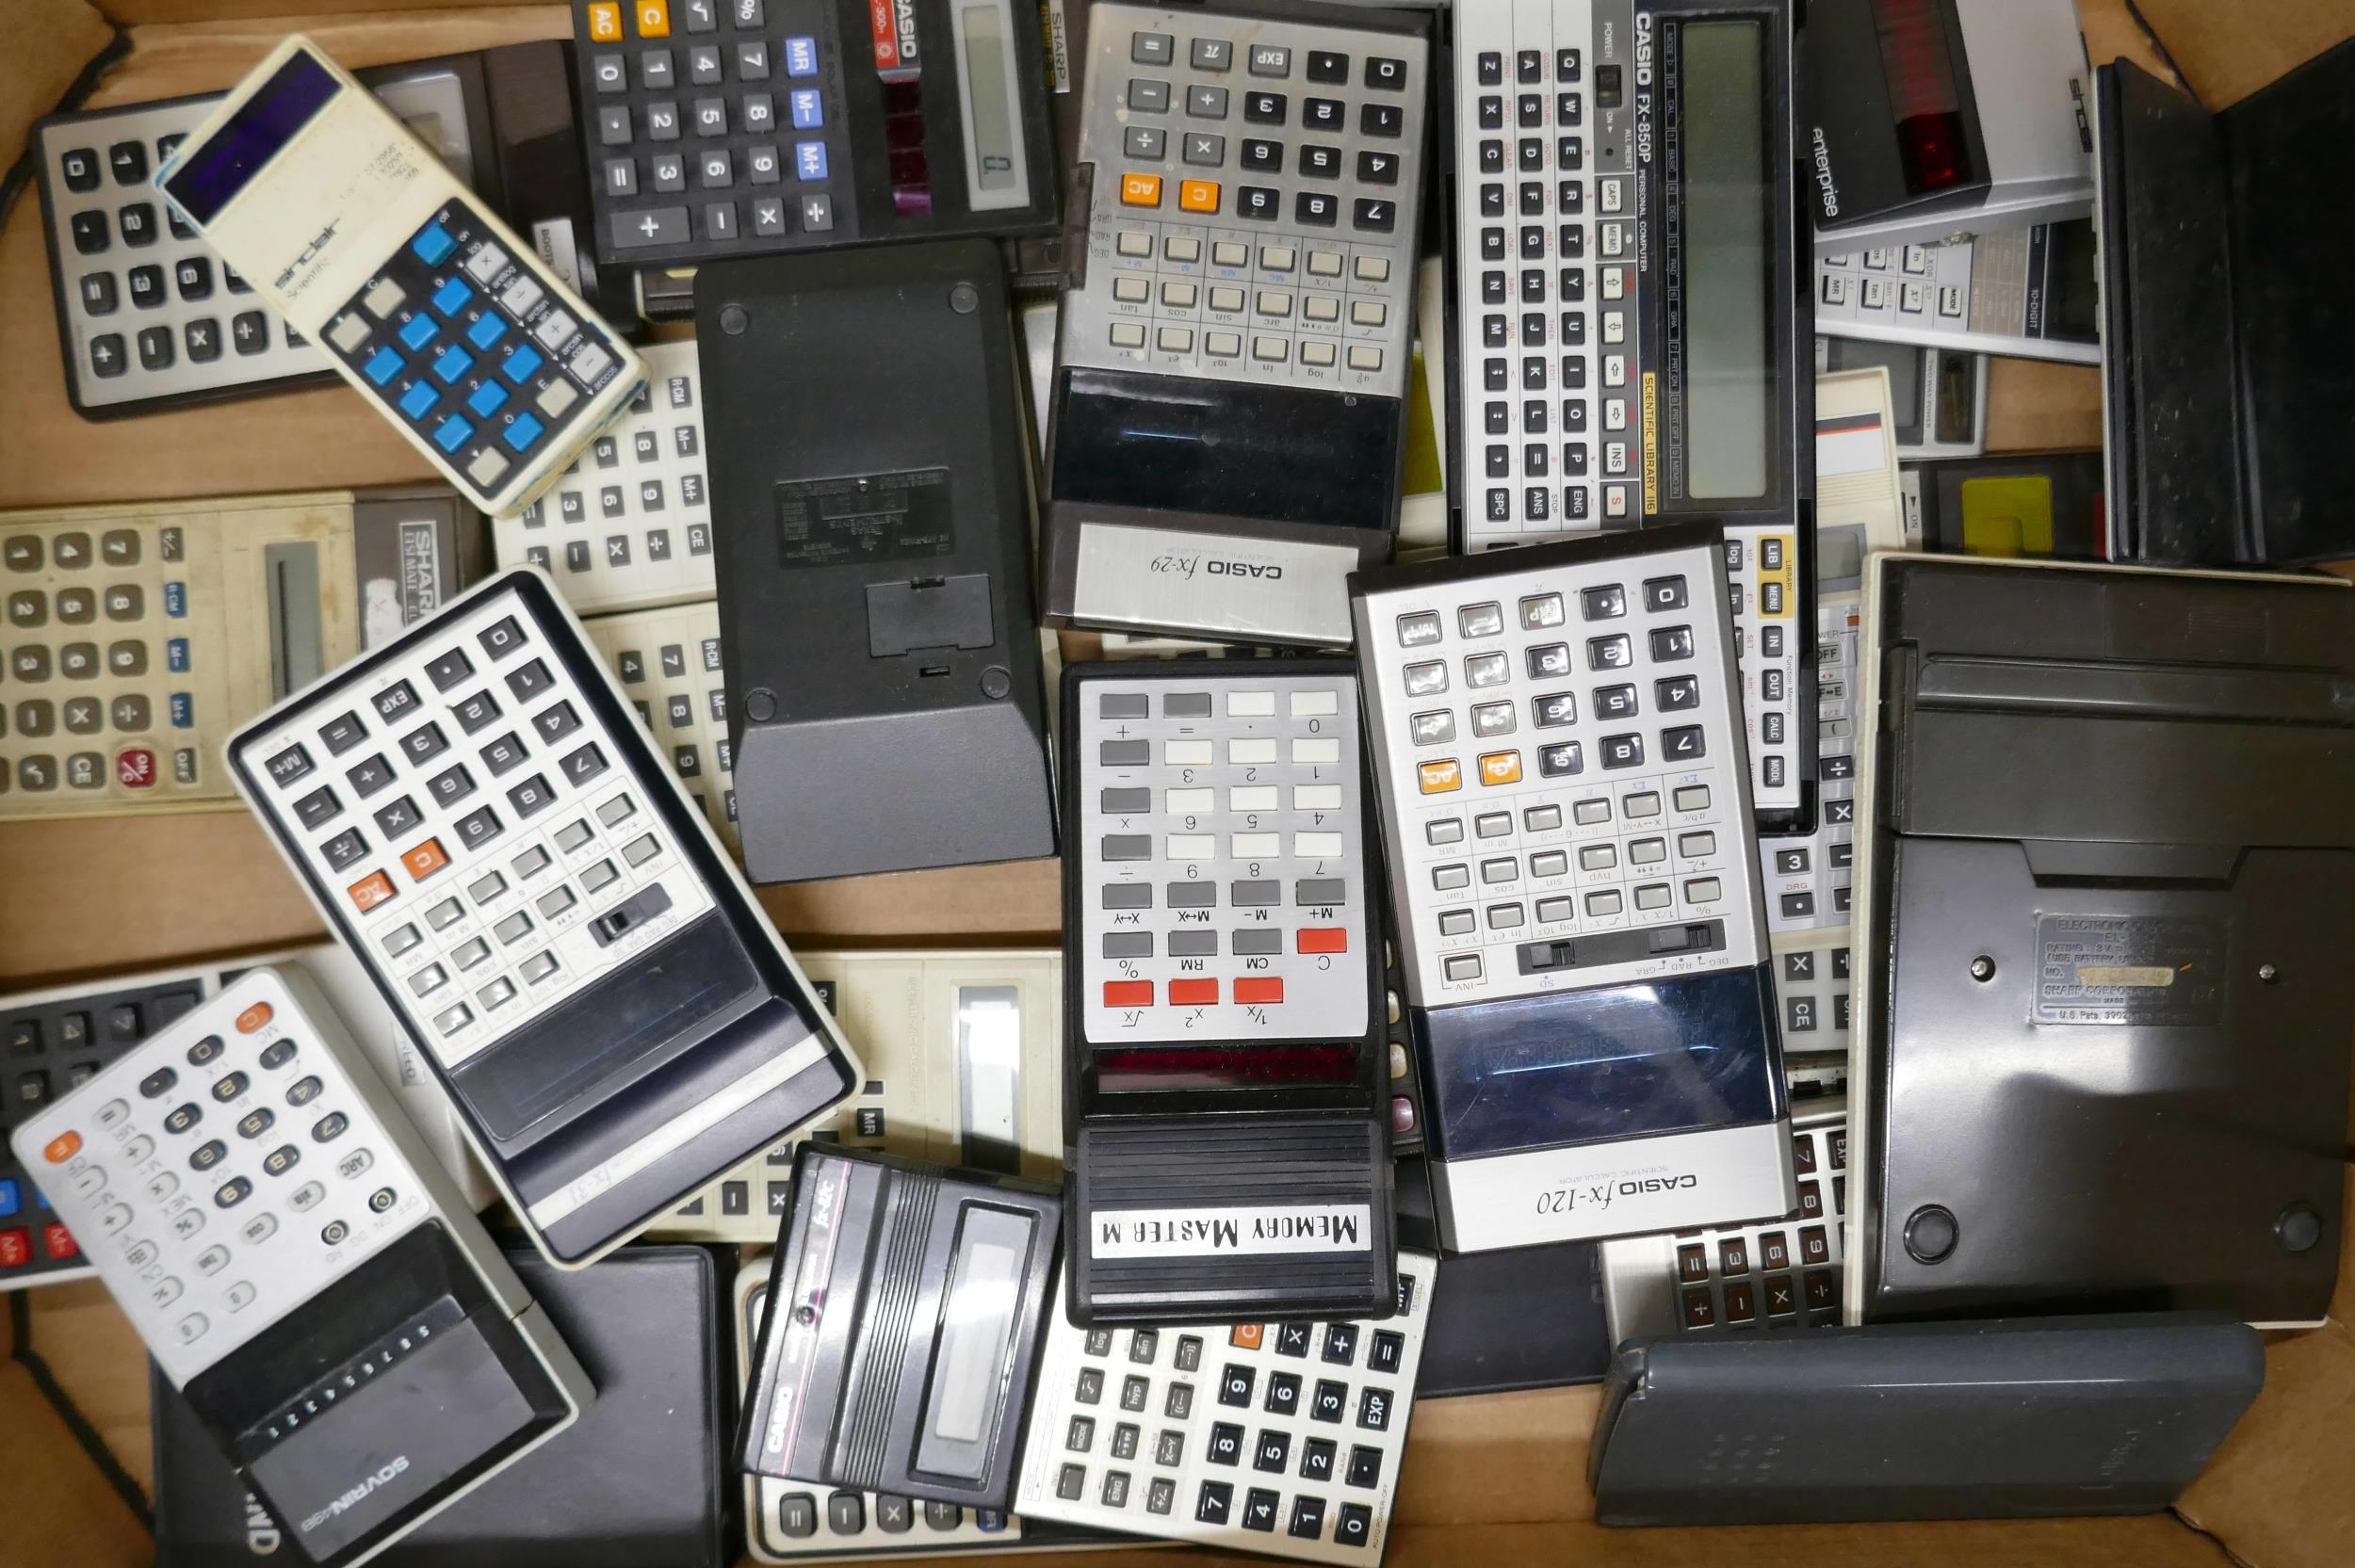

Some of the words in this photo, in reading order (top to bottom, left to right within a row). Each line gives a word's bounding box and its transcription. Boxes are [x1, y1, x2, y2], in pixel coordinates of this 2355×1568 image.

[596, 9, 613, 35] AC
[644, 8, 661, 25] C
[898, 0, 917, 57] ASIO
[1049, 9, 1068, 83] SHARP
[1604, 23, 1613, 58] POWER
[792, 41, 809, 71] MR
[1636, 12, 1651, 86] CASIO
[1258, 52, 1284, 66] EXP
[1486, 62, 1496, 71] Z
[1524, 59, 1535, 70] A
[1564, 57, 1575, 68] Q
[750, 105, 768, 121] 8
[1318, 105, 1332, 119] 2
[1525, 104, 1536, 113] S
[654, 114, 673, 128] 2
[1607, 111, 1614, 123] ON
[1638, 94, 1651, 163] FX-850P
[1566, 146, 1577, 155] E
[804, 146, 820, 174] M+
[707, 161, 725, 176] 6
[1813, 128, 1839, 218] enterprise
[1129, 181, 1154, 195] AC
[1608, 184, 1616, 206] CAPS
[439, 211, 450, 223] off
[1368, 205, 1381, 219] 7
[459, 231, 470, 242] on
[468, 243, 482, 257] log
[542, 229, 554, 267] BOOTS
[1639, 221, 1648, 272] COMPUTER
[286, 255, 331, 301] Scientific
[1832, 280, 1840, 295] MR
[2030, 289, 2039, 329] 10-DIGIT
[1491, 324, 1502, 335] M
[1669, 312, 1678, 331] GRA
[572, 345, 586, 357] cos
[595, 367, 618, 390] arccos
[1307, 368, 1324, 379] log
[1671, 375, 1679, 387] ON
[538, 380, 549, 391] E
[1645, 378, 1654, 438] SCIENTIFIC
[638, 440, 651, 451] 8
[1612, 448, 1622, 468] INS
[1646, 443, 1655, 489] LIBRARY
[684, 479, 697, 500] M+
[1495, 493, 1505, 515] SPC
[1534, 492, 1543, 514] ANS
[1574, 491, 1584, 513] ENG
[1612, 496, 1621, 505] S
[691, 529, 705, 548] CE
[1728, 546, 1741, 564] log
[1768, 545, 1778, 564] LIB
[1208, 561, 1282, 580] CASIO
[1659, 588, 1675, 603] 0
[1769, 586, 1778, 609] MENU
[492, 630, 509, 646] 0
[1769, 636, 1779, 648] IN
[1769, 673, 1779, 697] OUT
[382, 688, 410, 714] EXP
[172, 700, 184, 720] M+
[1309, 719, 1321, 734] 0
[1771, 718, 1779, 738] CALC
[1616, 745, 1631, 759] 8
[78, 758, 91, 783] CE
[177, 752, 188, 778] OFF
[273, 752, 301, 776] M+
[1771, 760, 1779, 783] MODE
[1183, 768, 1194, 784] 3
[1246, 768, 1257, 783] 2
[441, 779, 457, 793] 6
[1247, 815, 1258, 829] 5
[1249, 863, 1260, 878] 8
[1789, 855, 1802, 870] 3
[1589, 872, 1611, 881] hyp
[1309, 908, 1333, 919] M+
[1181, 960, 1203, 971] RM
[1247, 958, 1269, 969] CM
[1318, 955, 1331, 971] C
[1671, 962, 1692, 970] RAD
[1709, 957, 1730, 966] DEG
[1635, 966, 1656, 976] GRA
[1455, 982, 1474, 992] INV
[1540, 978, 1554, 988] SD
[1795, 1004, 1810, 1027] CE
[864, 1112, 876, 1134] MR
[340, 1156, 364, 1176] ARC
[1559, 1172, 1612, 1184] CALCULATOR
[1619, 1174, 1697, 1196] CASIO
[1537, 1183, 1613, 1215] fx-120
[1103, 1223, 1121, 1244] M
[1095, 1333, 1108, 1350] log
[1140, 1340, 1149, 1356] sin
[1129, 1385, 1142, 1405] hyp
[1368, 1397, 1384, 1425] EXP
[768, 1384, 797, 1457] CASIO
[1076, 1423, 1088, 1449] MODE
[1266, 1447, 1281, 1460] 5
[1112, 1480, 1123, 1501] ENG
[1347, 1520, 1362, 1533] 0
